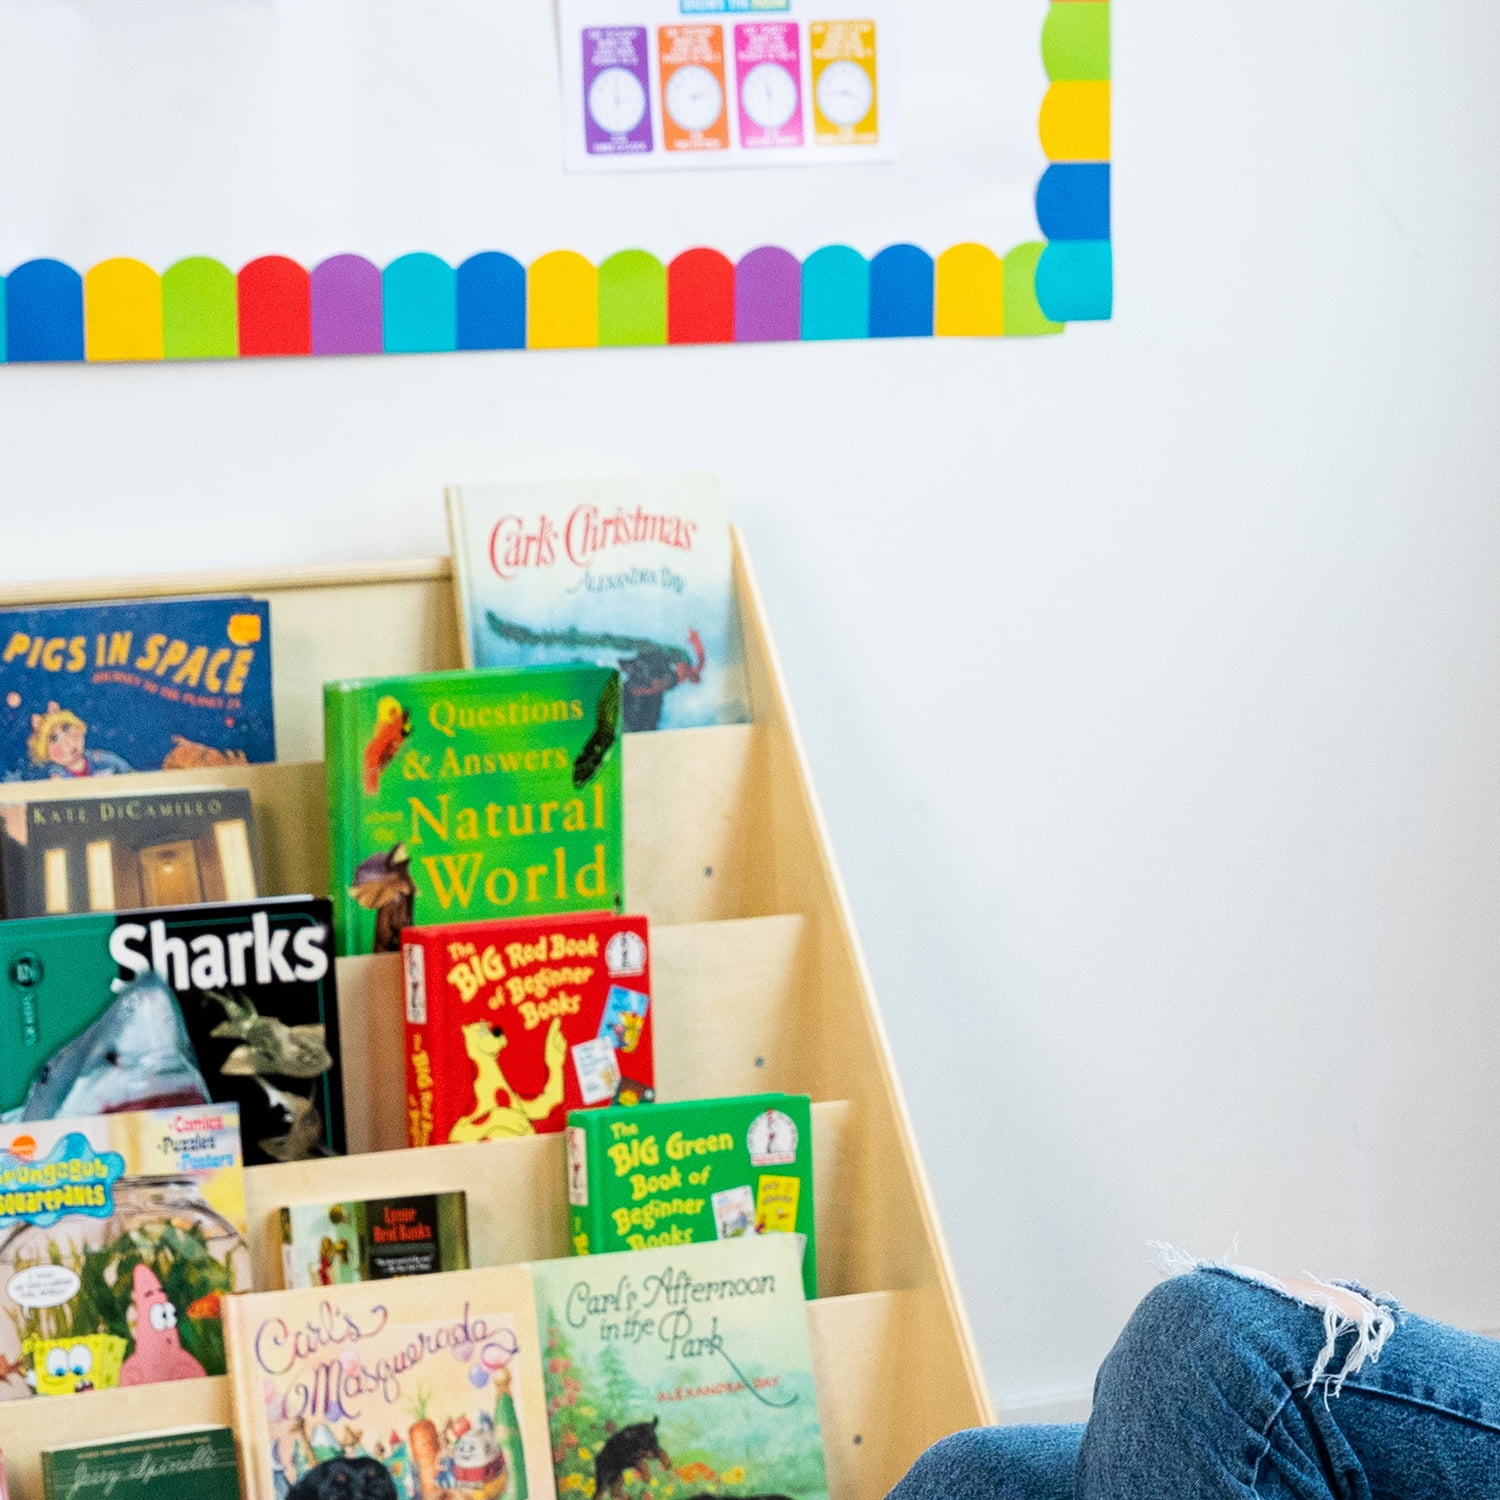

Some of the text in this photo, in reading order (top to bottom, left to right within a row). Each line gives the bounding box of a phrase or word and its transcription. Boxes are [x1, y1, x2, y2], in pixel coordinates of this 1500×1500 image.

[488, 503, 697, 581] Carl's Christmas
[3, 632, 87, 673] PIGS
[95, 630, 133, 668] IN
[134, 632, 254, 694] SPACE
[428, 693, 584, 737] Questions
[401, 747, 568, 780] & Answers
[407, 783, 605, 844] Natural
[421, 844, 606, 910] World
[108, 911, 329, 993] Sharks
[446, 944, 507, 1003] BIG
[504, 935, 549, 969] Red
[549, 932, 599, 960] Book
[487, 966, 594, 1010] of Beginner
[517, 990, 582, 1031] Books
[174, 1115, 223, 1133] Comics
[607, 1135, 660, 1177] BIG
[665, 1131, 734, 1160] Green
[629, 1165, 712, 1201] Book of
[611, 1198, 705, 1236] Beginner
[626, 1223, 693, 1250] Books
[565, 1266, 776, 1328] Carl's Afternoon
[600, 1308, 723, 1360] in the Park
[254, 1300, 520, 1421] Carl's Masquerade
